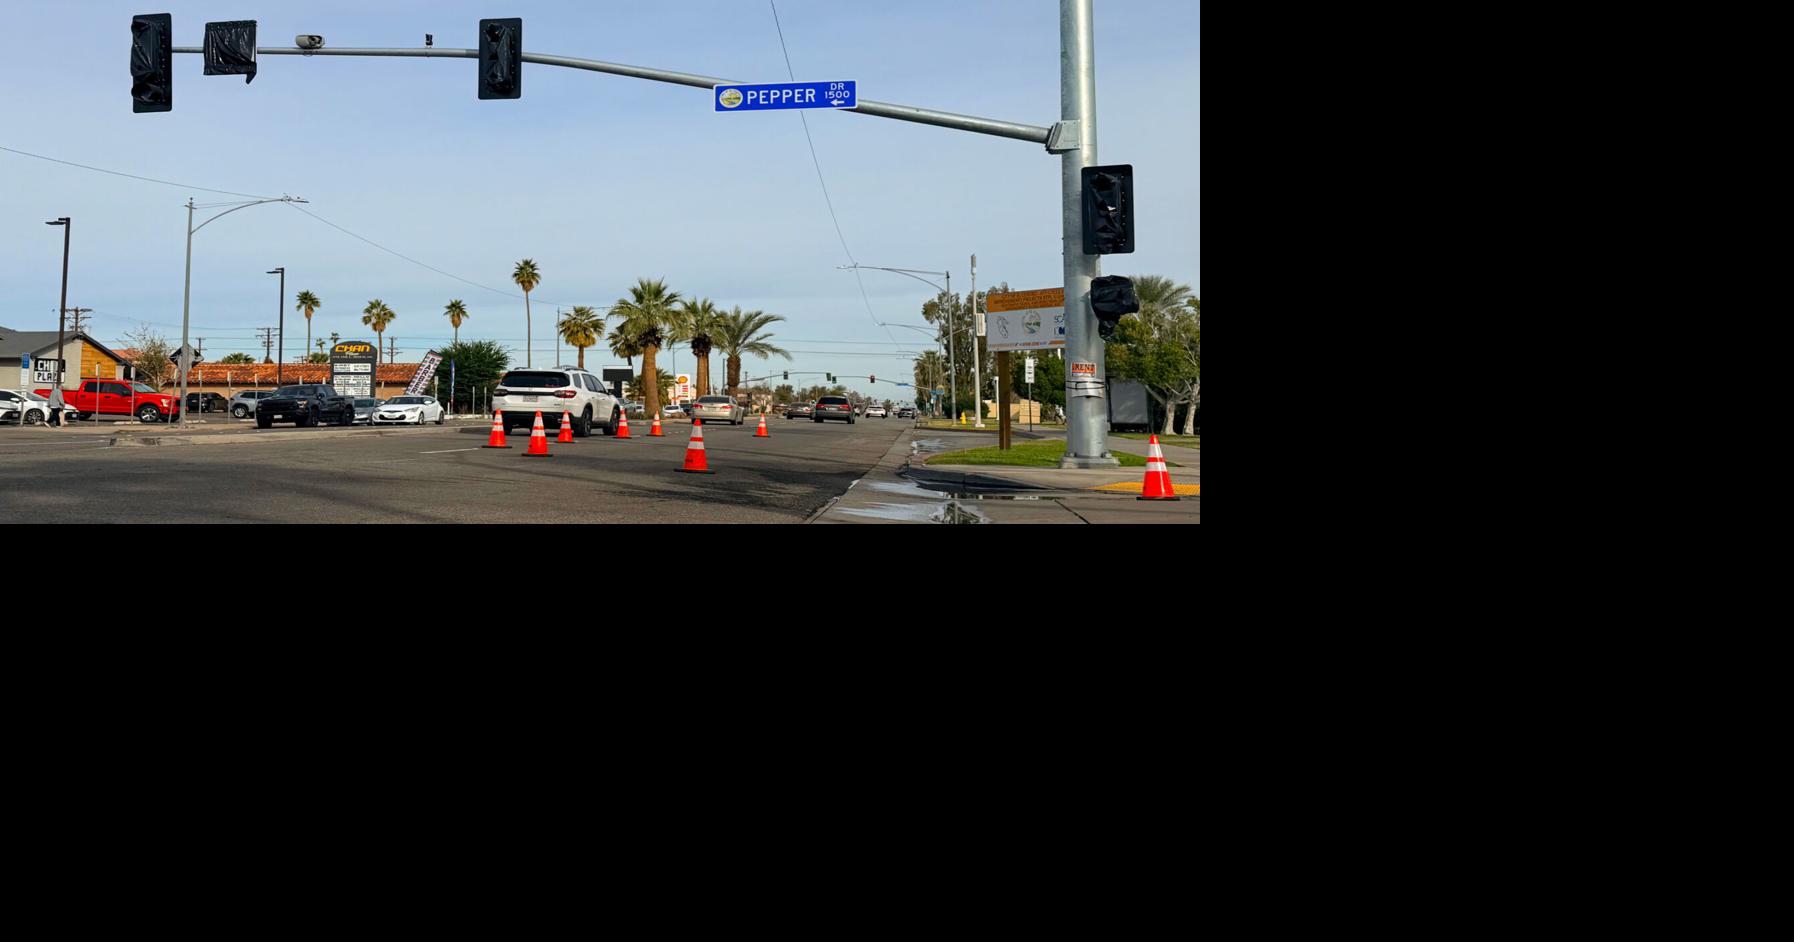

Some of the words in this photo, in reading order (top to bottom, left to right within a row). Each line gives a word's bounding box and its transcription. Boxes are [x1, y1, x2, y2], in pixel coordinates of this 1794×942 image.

[830, 82, 845, 91] DR
[747, 88, 816, 105] PEPPER
[824, 90, 850, 99] 1500
[335, 345, 371, 353] CHAN
[37, 360, 61, 371] CH
[37, 372, 61, 381] PLAZ
[409, 357, 436, 395] BARBER
